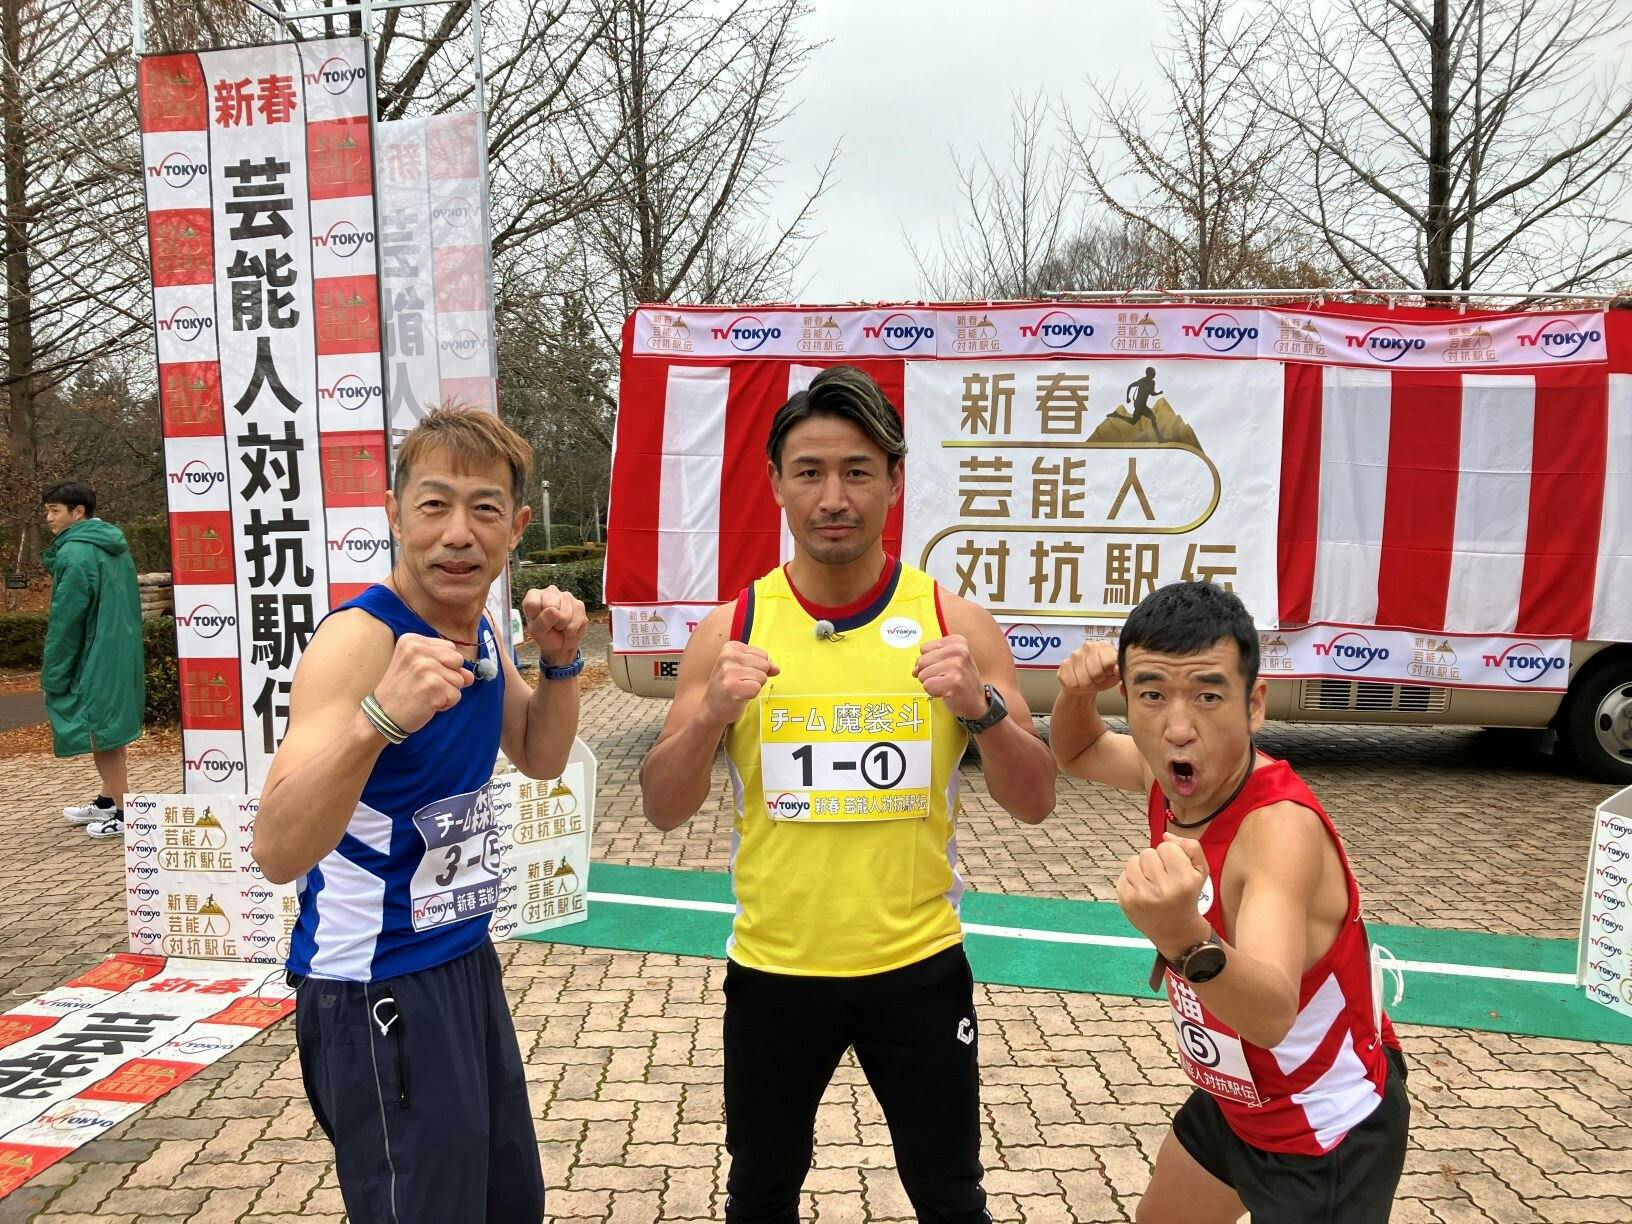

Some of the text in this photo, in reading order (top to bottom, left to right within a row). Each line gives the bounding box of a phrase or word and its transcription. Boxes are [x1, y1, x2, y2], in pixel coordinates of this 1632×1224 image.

[304, 67, 366, 85] TV TOKYO
[214, 74, 297, 127] 新春
[147, 163, 207, 177] TV TOKYO
[313, 232, 374, 247] TV TOKYO
[158, 317, 213, 331] TV TOKYO
[1019, 324, 1094, 338] TV TOKYO
[1182, 325, 1259, 340] TV TOKYO
[711, 327, 781, 341] TV TOKYO
[863, 326, 934, 340] TV TOKYO
[1517, 330, 1601, 347] TV TOKYO
[1345, 335, 1425, 350] TV TOKYO
[319, 385, 382, 400] TV TOKYO
[961, 372, 1090, 435] 新春
[169, 471, 225, 483] TV TOKYO
[959, 455, 1156, 520] 芸能人
[328, 538, 390, 552] TV TOKYO
[176, 615, 236, 627] TV TOKYO
[1009, 634, 1061, 648] TOKYO
[1313, 643, 1389, 660] TV TOKYO
[660, 662, 681, 676] BE
[1483, 654, 1565, 671] TV TOKYO
[771, 702, 924, 734] チーム 魔裟斗
[186, 760, 244, 772] TV TOKYO
[519, 781, 548, 799] 新春
[520, 799, 564, 821] 芸能人
[767, 801, 810, 811] TV TOKYO
[815, 797, 840, 814] 新春
[164, 806, 195, 824] 新春
[520, 815, 582, 841] 対抗駅伝
[165, 829, 212, 847] 芸能人
[165, 851, 232, 869] 対抗駅伝
[528, 860, 554, 878] 新春
[528, 878, 568, 900] 芸能人
[168, 894, 198, 911] 新春
[414, 901, 454, 919] TV TOKYO
[457, 892, 477, 912] 新春
[529, 894, 583, 919] 対抗駅伝
[169, 916, 216, 934] 芸能人
[170, 939, 237, 955] 対抗駅伝
[141, 977, 253, 994] 新春
[1170, 975, 1204, 1025] 猫
